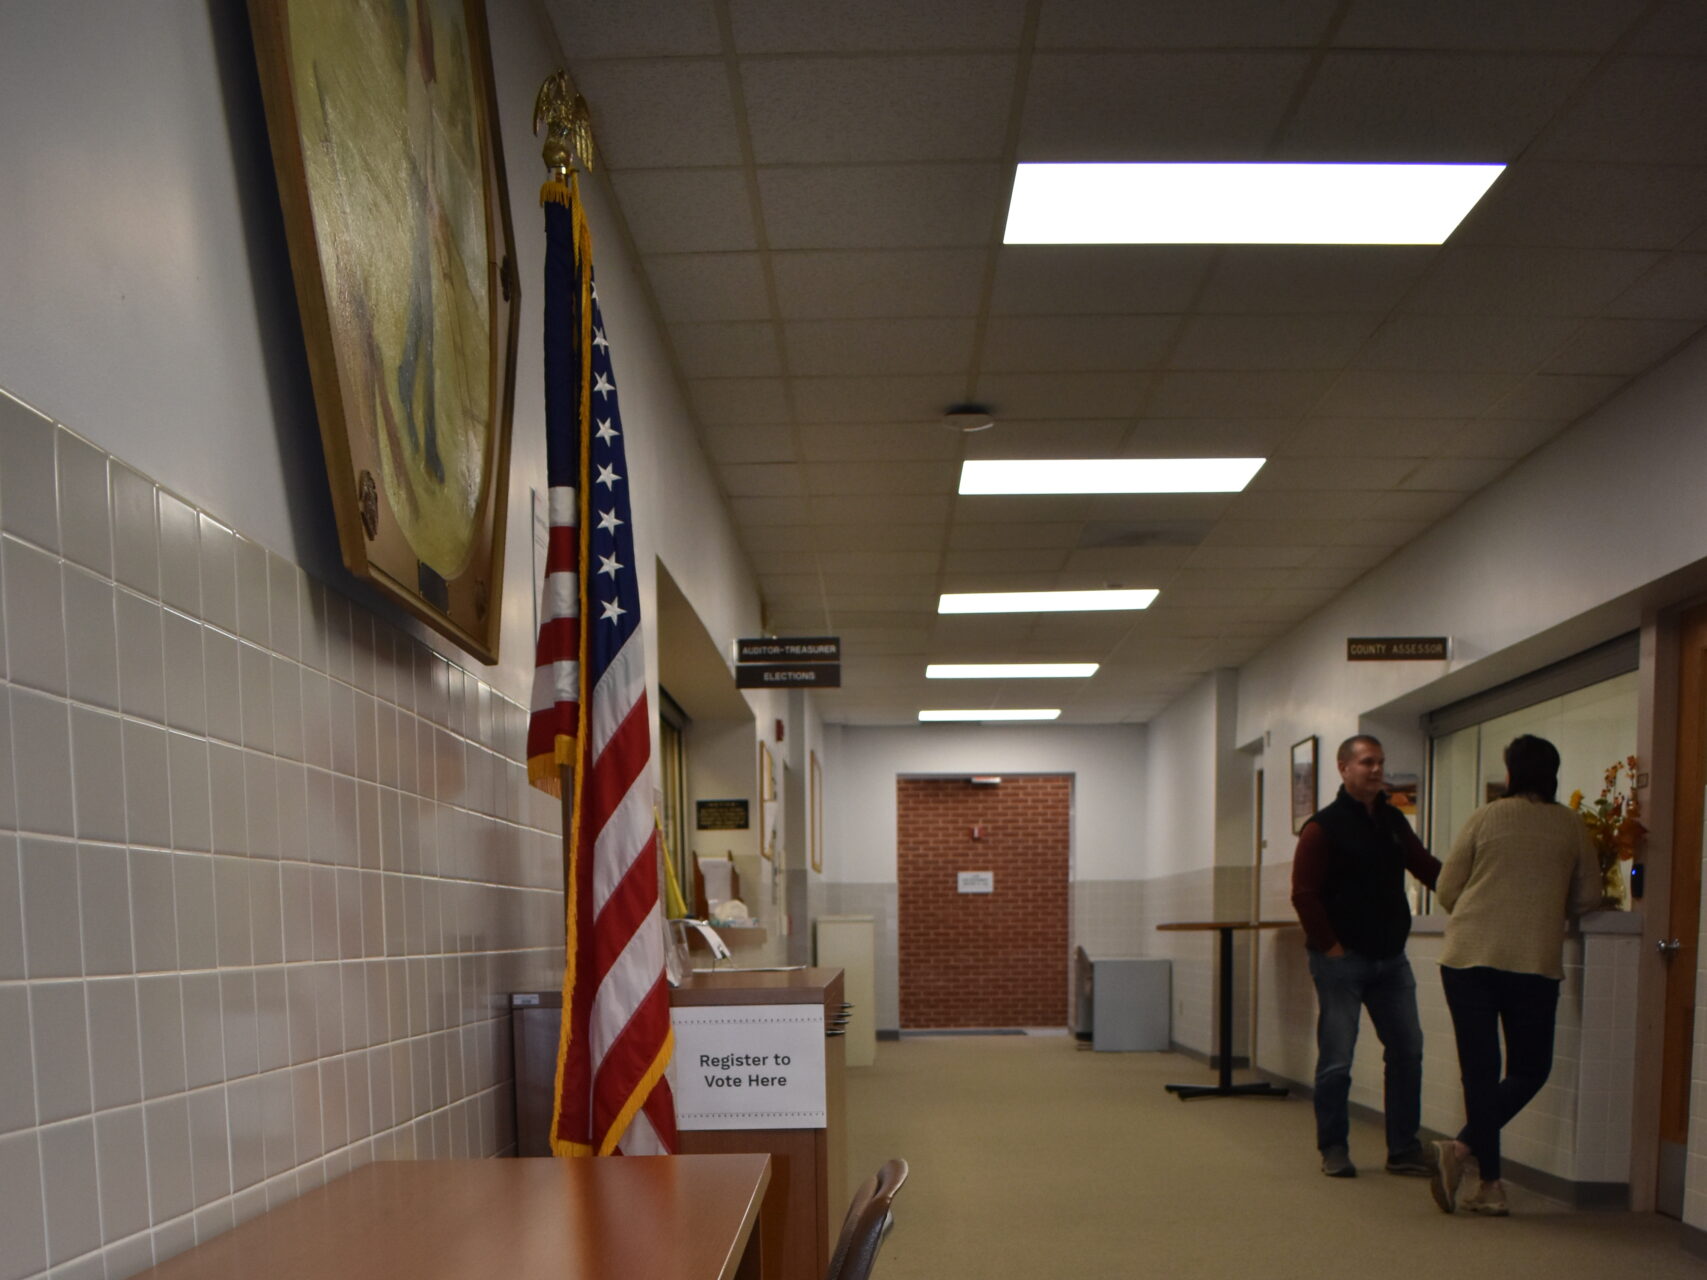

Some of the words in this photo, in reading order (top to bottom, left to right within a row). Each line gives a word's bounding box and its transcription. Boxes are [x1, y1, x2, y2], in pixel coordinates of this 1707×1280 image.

[742, 645, 836, 655] AUDITOR-TREASURER
[1350, 643, 1387, 655] COUNTY
[1391, 643, 1443, 655] ASSESSOR
[763, 671, 816, 681] ELECTIONS
[699, 1053, 769, 1071] Register
[773, 1053, 791, 1066] to
[704, 1075, 742, 1088] Vote
[748, 1074, 787, 1087] Here
